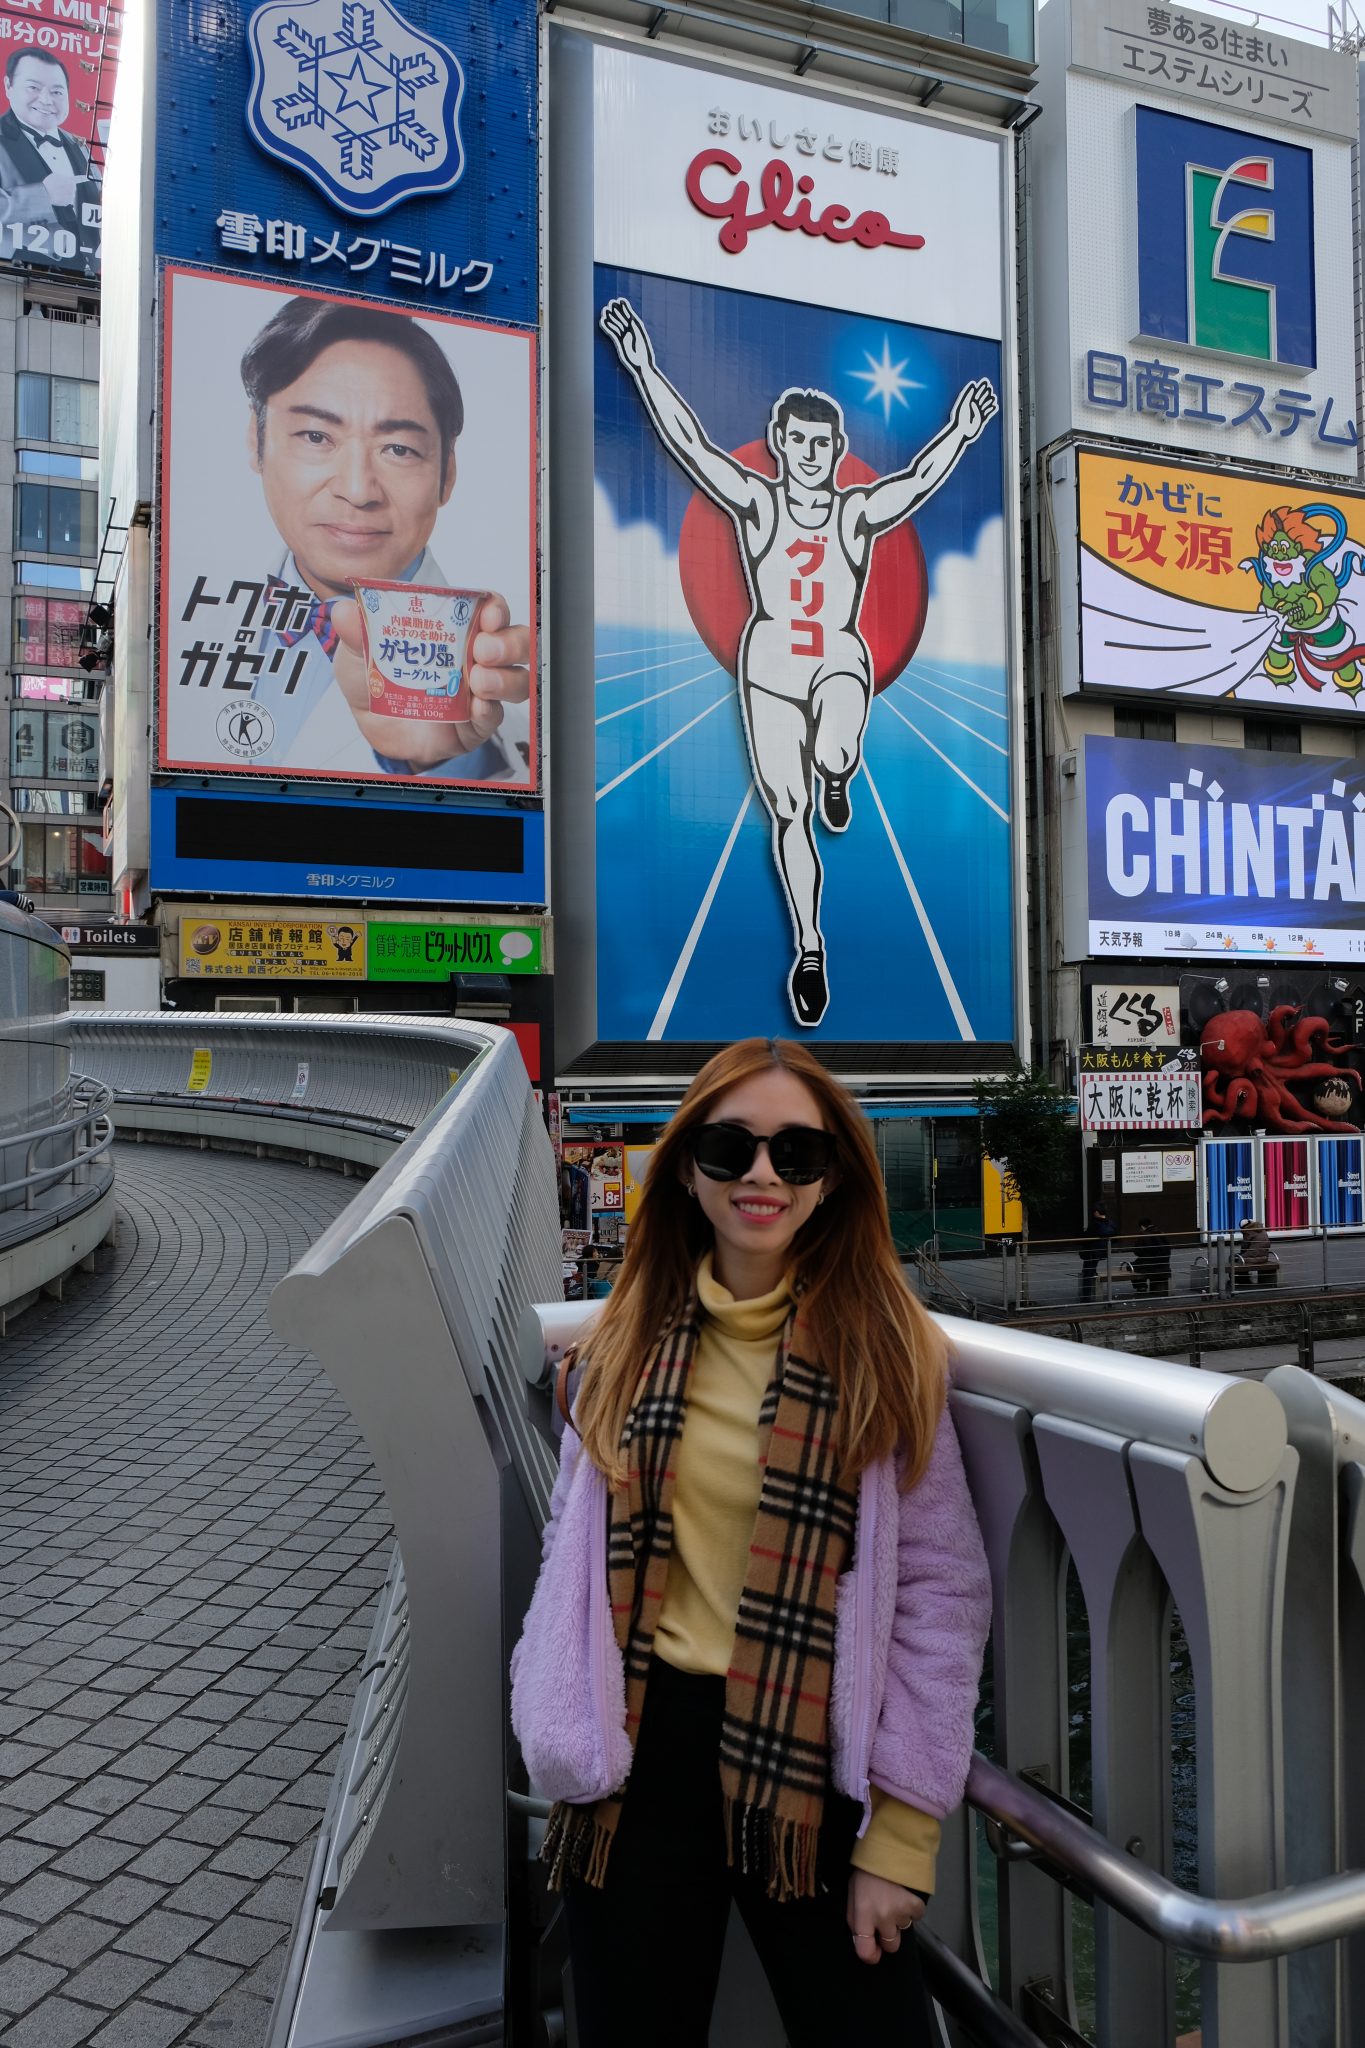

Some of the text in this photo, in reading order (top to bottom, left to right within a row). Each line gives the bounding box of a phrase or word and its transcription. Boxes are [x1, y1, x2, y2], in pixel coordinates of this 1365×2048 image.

[54, 0, 123, 28] MILLI
[1147, 6, 1288, 67] 夢ある住まい
[1123, 45, 1312, 118] エステムシリーズ
[708, 106, 899, 176] おいしさと健康
[686, 148, 926, 254] Glico
[0, 222, 102, 259] 120-
[216, 209, 493, 292] 雪印メグミルク
[1087, 350, 1359, 447] 日商エステム
[1117, 473, 1223, 518] かぜに
[1105, 510, 1234, 575] 改源
[181, 576, 314, 632] トクホ
[408, 595, 425, 612] 恵
[785, 535, 828, 657] グリコ
[234, 629, 256, 643] の
[383, 625, 456, 643] 減らすのを助ける
[391, 615, 444, 631] 内臓脂肪を
[24, 645, 45, 662] 5F
[180, 641, 309, 695] ガセリ
[393, 667, 441, 682] ヨーグルト
[16, 724, 34, 763] 4F
[306, 873, 395, 889] 雪印メグミルク
[84, 929, 136, 943] Toilets
[228, 927, 323, 943] 店舗情報館
[425, 930, 494, 963] ピタットハウス
[1099, 930, 1143, 948] 天気予報
[205, 964, 306, 975] 株式会社 関西インベスト
[1108, 992, 1164, 1037] くくる
[1082, 1052, 1167, 1069] 大阪もんを食す
[1184, 1061, 1198, 1071] 2F
[1088, 1082, 1184, 1120] 大阪に乾杯
[605, 1191, 620, 1205] 8F
